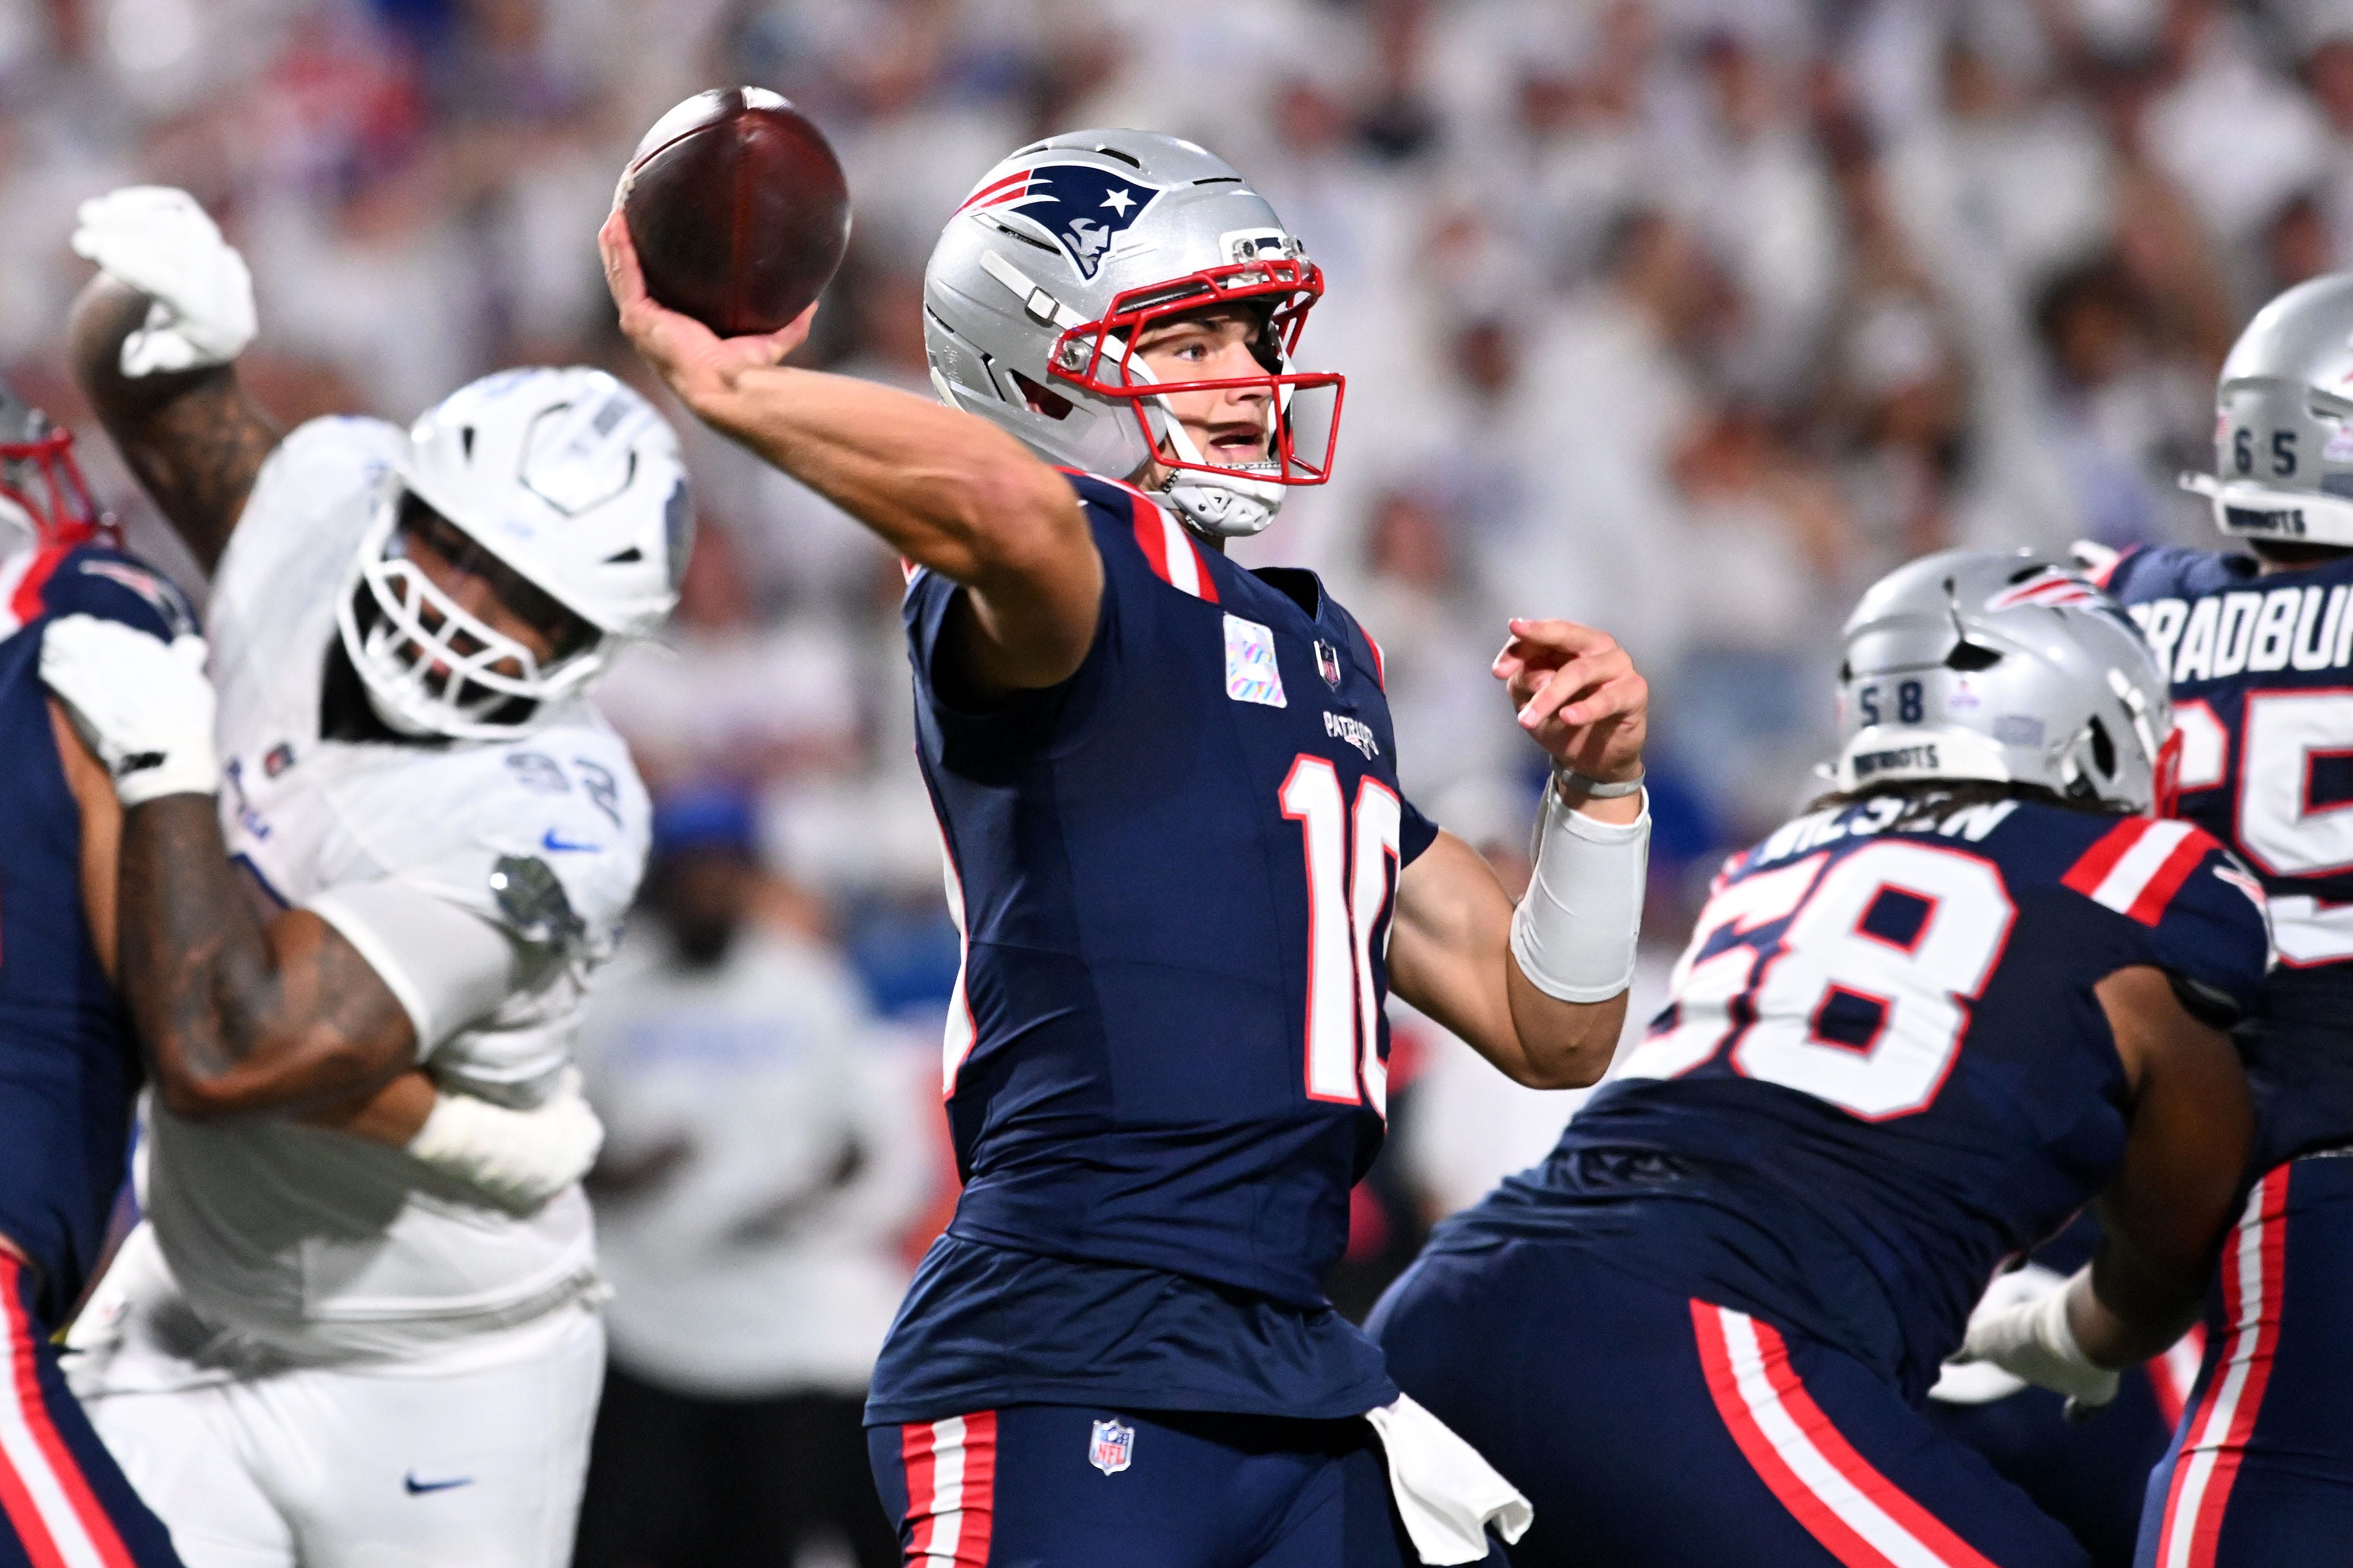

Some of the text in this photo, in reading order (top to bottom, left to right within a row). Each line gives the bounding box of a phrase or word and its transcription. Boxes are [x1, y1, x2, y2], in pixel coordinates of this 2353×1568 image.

[2234, 428, 2297, 476] 65
[1860, 679, 1924, 728] 58
[1278, 752, 1401, 1133] 10
[1612, 839, 2019, 1123] 58
[1096, 1443, 1125, 1464] NFL
